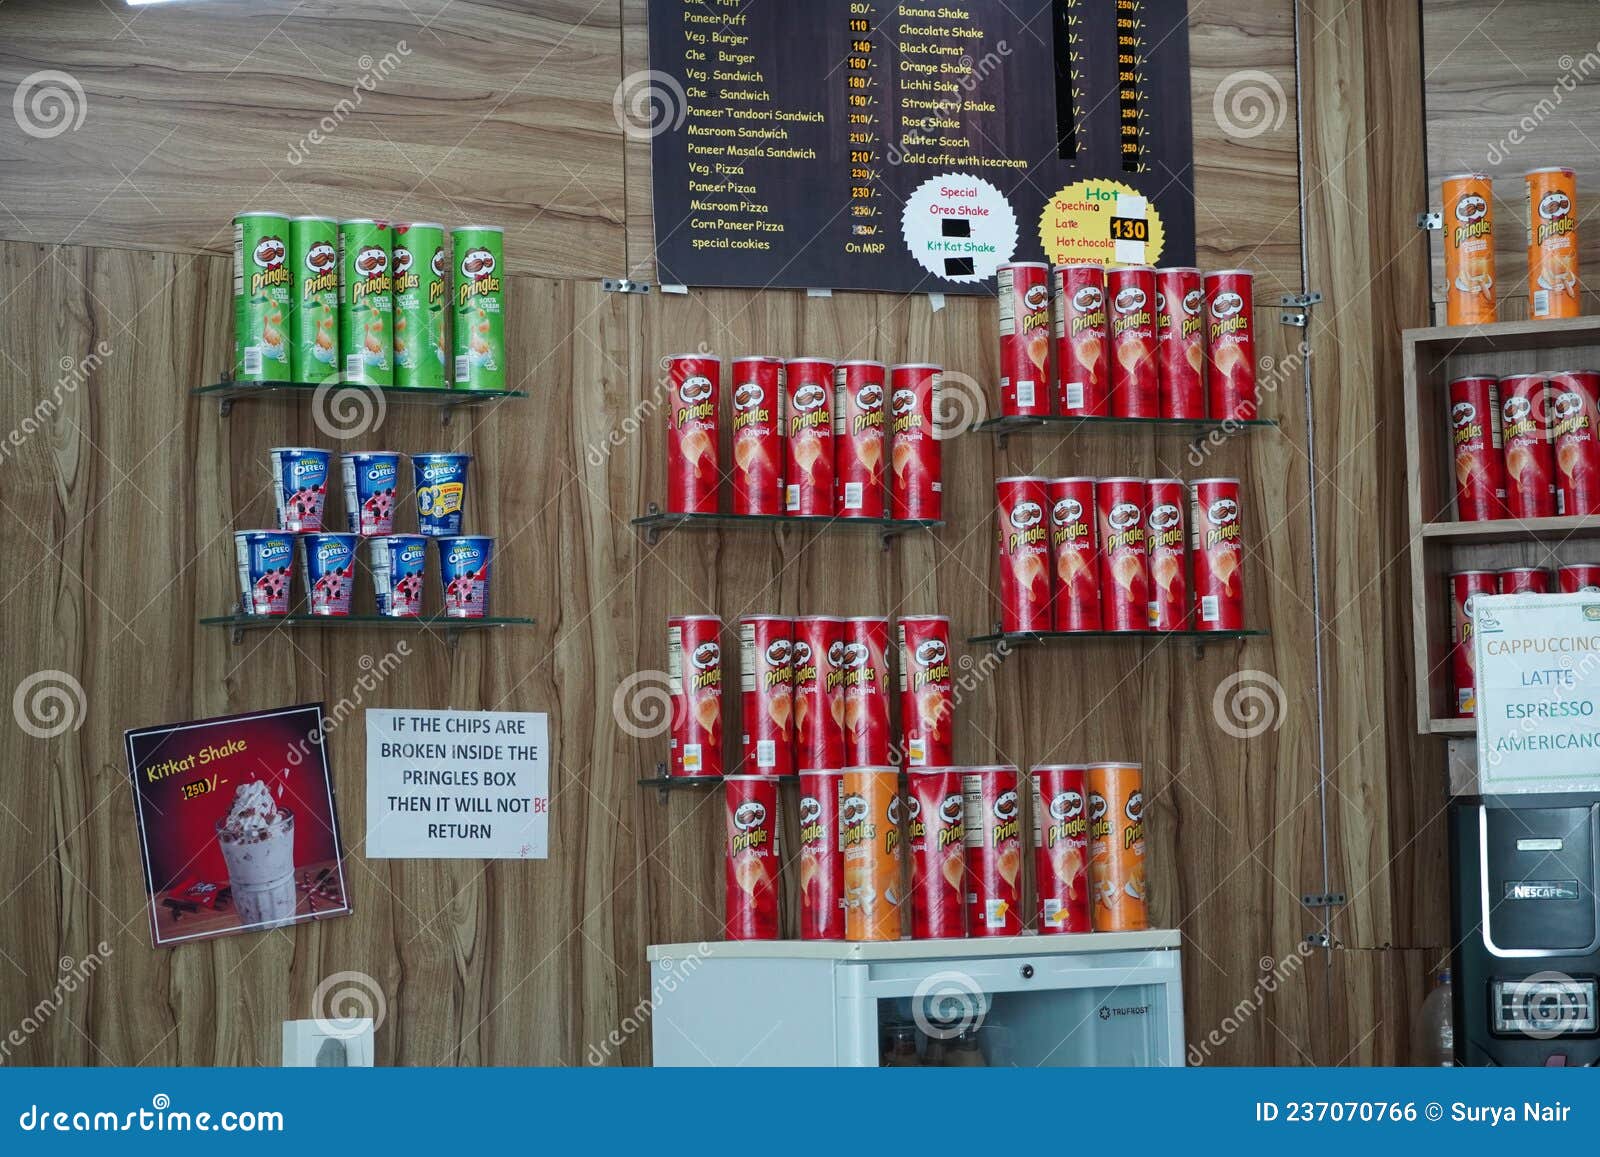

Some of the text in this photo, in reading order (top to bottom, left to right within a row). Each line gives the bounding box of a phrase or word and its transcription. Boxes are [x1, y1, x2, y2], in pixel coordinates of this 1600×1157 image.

[850, 3, 876, 14] 80/-
[898, 6, 970, 20] Banana Shake
[684, 12, 746, 26] Paneer Puff
[899, 24, 984, 38] Chocolate Shake
[684, 31, 748, 46] Veg. Burger
[900, 42, 928, 54] Black
[685, 50, 755, 65] Che Burger
[900, 61, 972, 75] Orange Shake
[686, 69, 764, 83] Veg. Sandwich
[900, 79, 959, 92] Lichhi Sake
[686, 88, 770, 102] Che Sandwich
[964, 100, 996, 112] Shake
[686, 106, 824, 122] Paneer Tandoori Sandwich
[902, 116, 960, 129] Rose Shake
[688, 125, 788, 140] Masroom Sandwich
[939, 136, 970, 148] Scoch
[688, 144, 816, 160] Paneer Masala Sandwich
[903, 152, 1028, 168] Cold coffe with icecream
[688, 163, 744, 175] Veg. Pizza
[689, 182, 726, 193] Paneer
[940, 187, 978, 198] Special
[1086, 188, 1120, 201] Hot
[690, 200, 768, 213] Masroom Pizza
[930, 205, 990, 216] Oreo Shake
[690, 219, 784, 232] Corn Paneer Pizza
[1112, 219, 1145, 239] 130
[692, 238, 770, 250] special cookies
[845, 242, 885, 254] On MRP
[927, 241, 996, 253] Kit Kat Shake
[1056, 237, 1075, 247] Hot
[460, 278, 500, 307] Pringles
[1210, 314, 1248, 342] Pringles
[791, 408, 830, 438] Pringles
[1522, 669, 1574, 686] LATTE
[1506, 700, 1594, 719] ESPRESSO
[392, 716, 526, 734] IF THE CHIPS ARE
[382, 743, 538, 760] BROKEN INSIDE THE
[146, 739, 248, 783] Kitkat Shake
[403, 770, 516, 786] PRINGLES BOX
[388, 796, 547, 814] THEN IT WILL NOT BE
[428, 824, 492, 839] RETURN
